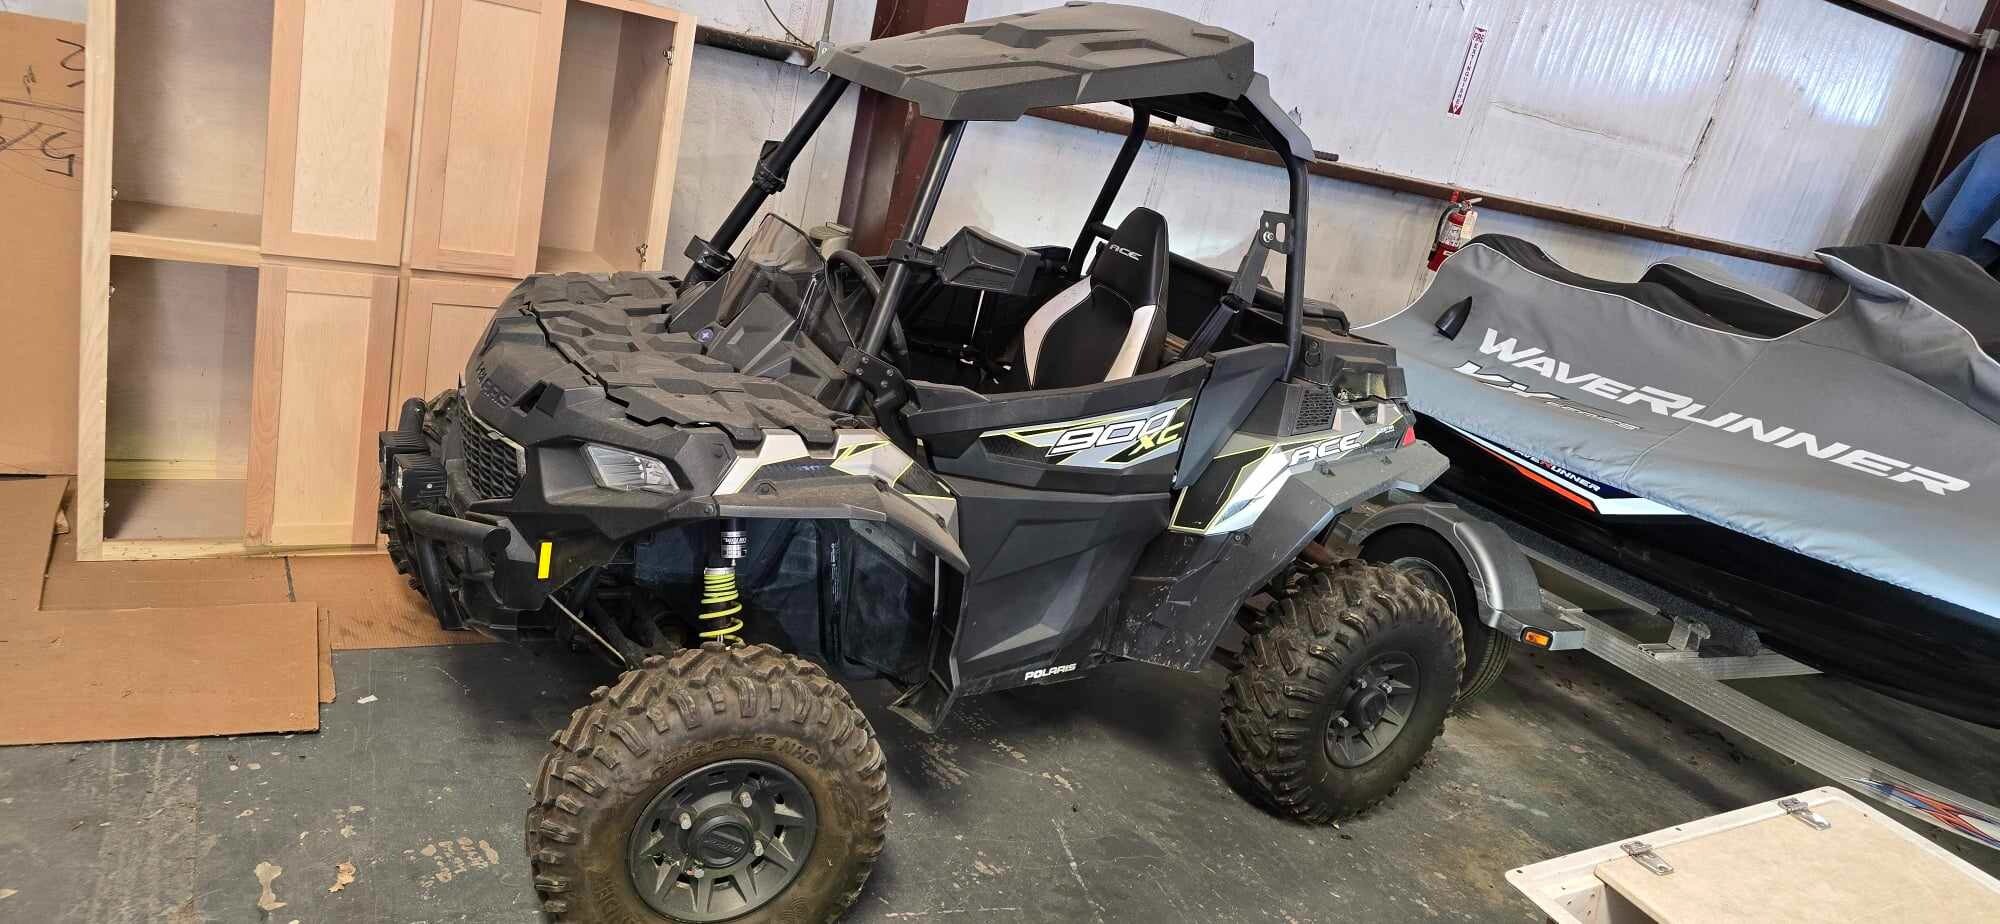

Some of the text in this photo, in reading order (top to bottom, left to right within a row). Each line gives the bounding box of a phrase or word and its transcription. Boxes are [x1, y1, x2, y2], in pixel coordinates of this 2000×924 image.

[1109, 244, 1143, 261] ACE
[1046, 407, 1185, 458] 900 XC
[1288, 430, 1364, 468] ACE
[1024, 663, 1078, 681] POLARIS
